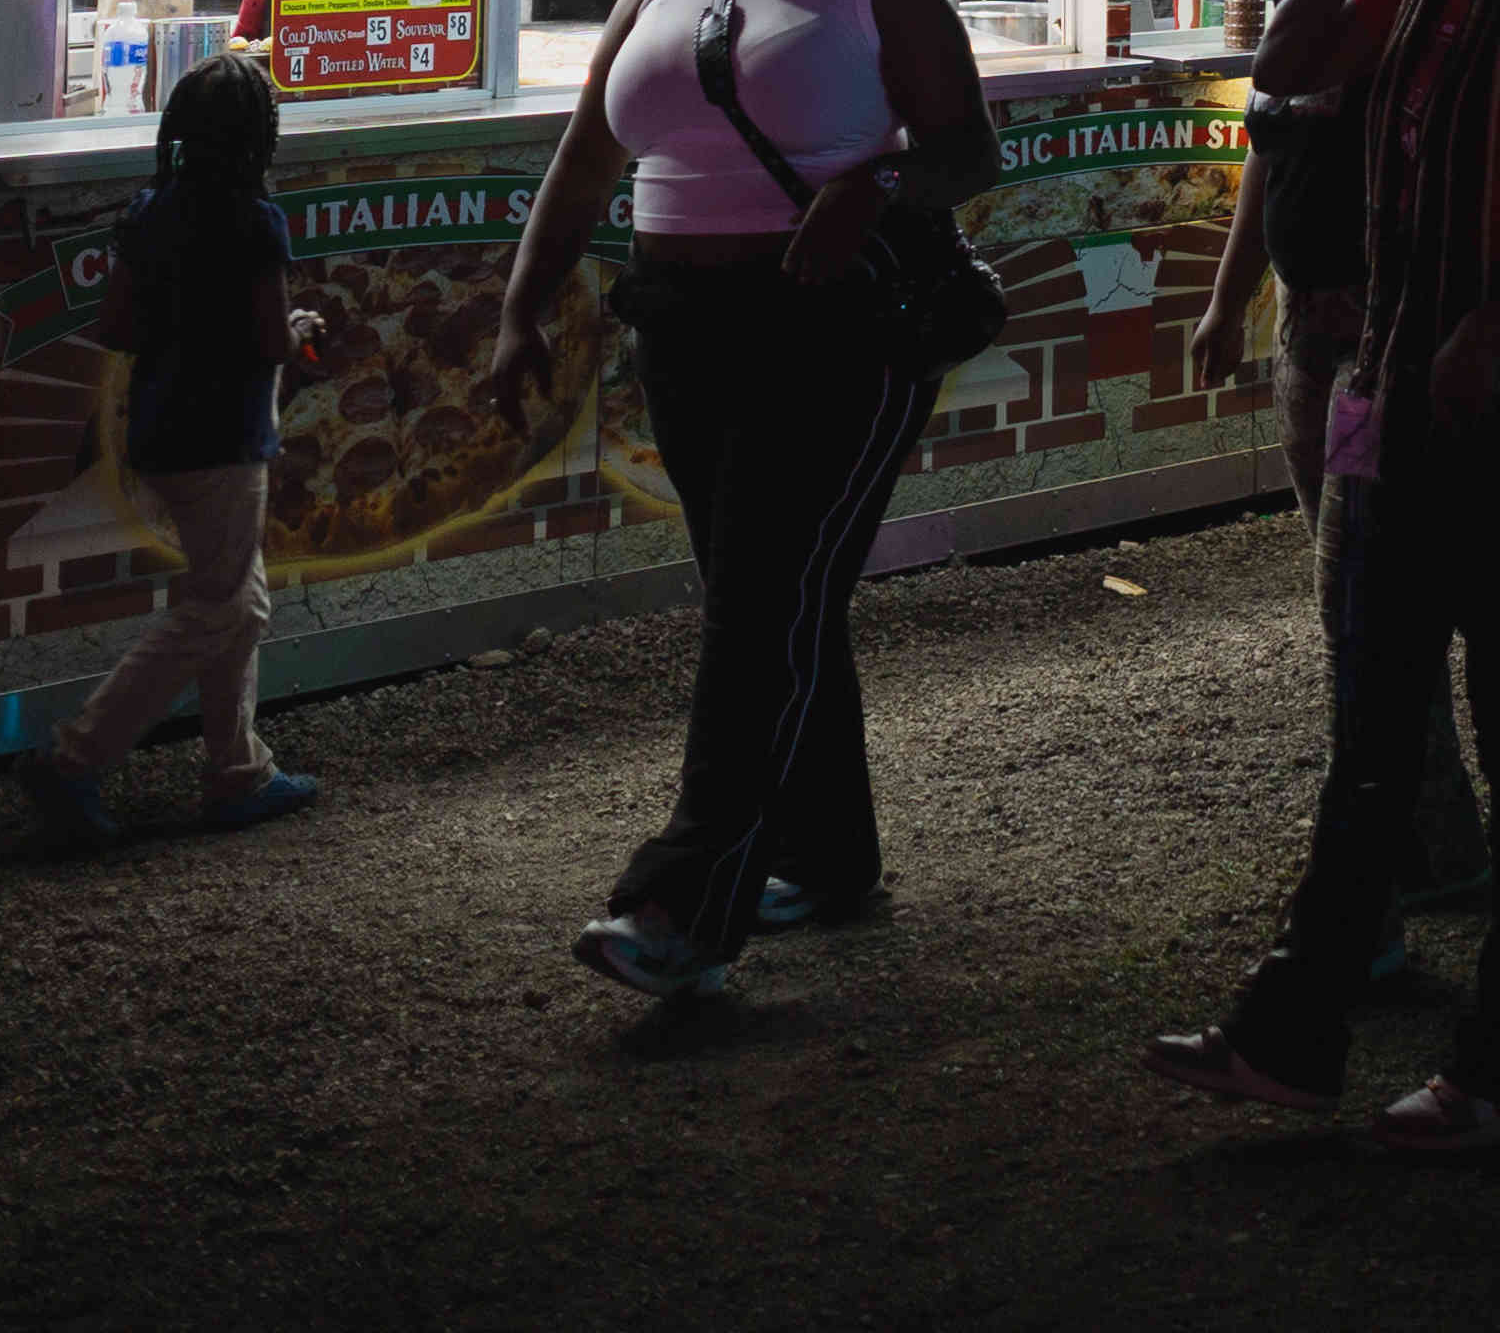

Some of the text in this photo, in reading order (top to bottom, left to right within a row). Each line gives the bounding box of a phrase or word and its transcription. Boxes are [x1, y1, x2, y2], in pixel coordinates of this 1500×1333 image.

[283, 2, 306, 12] Choose
[369, 19, 388, 42] $5
[450, 15, 468, 37] $8
[291, 58, 303, 79] 4
[412, 47, 430, 68] $4
[1067, 118, 1195, 159] ITALIAN
[303, 190, 487, 239] ITALIAN
